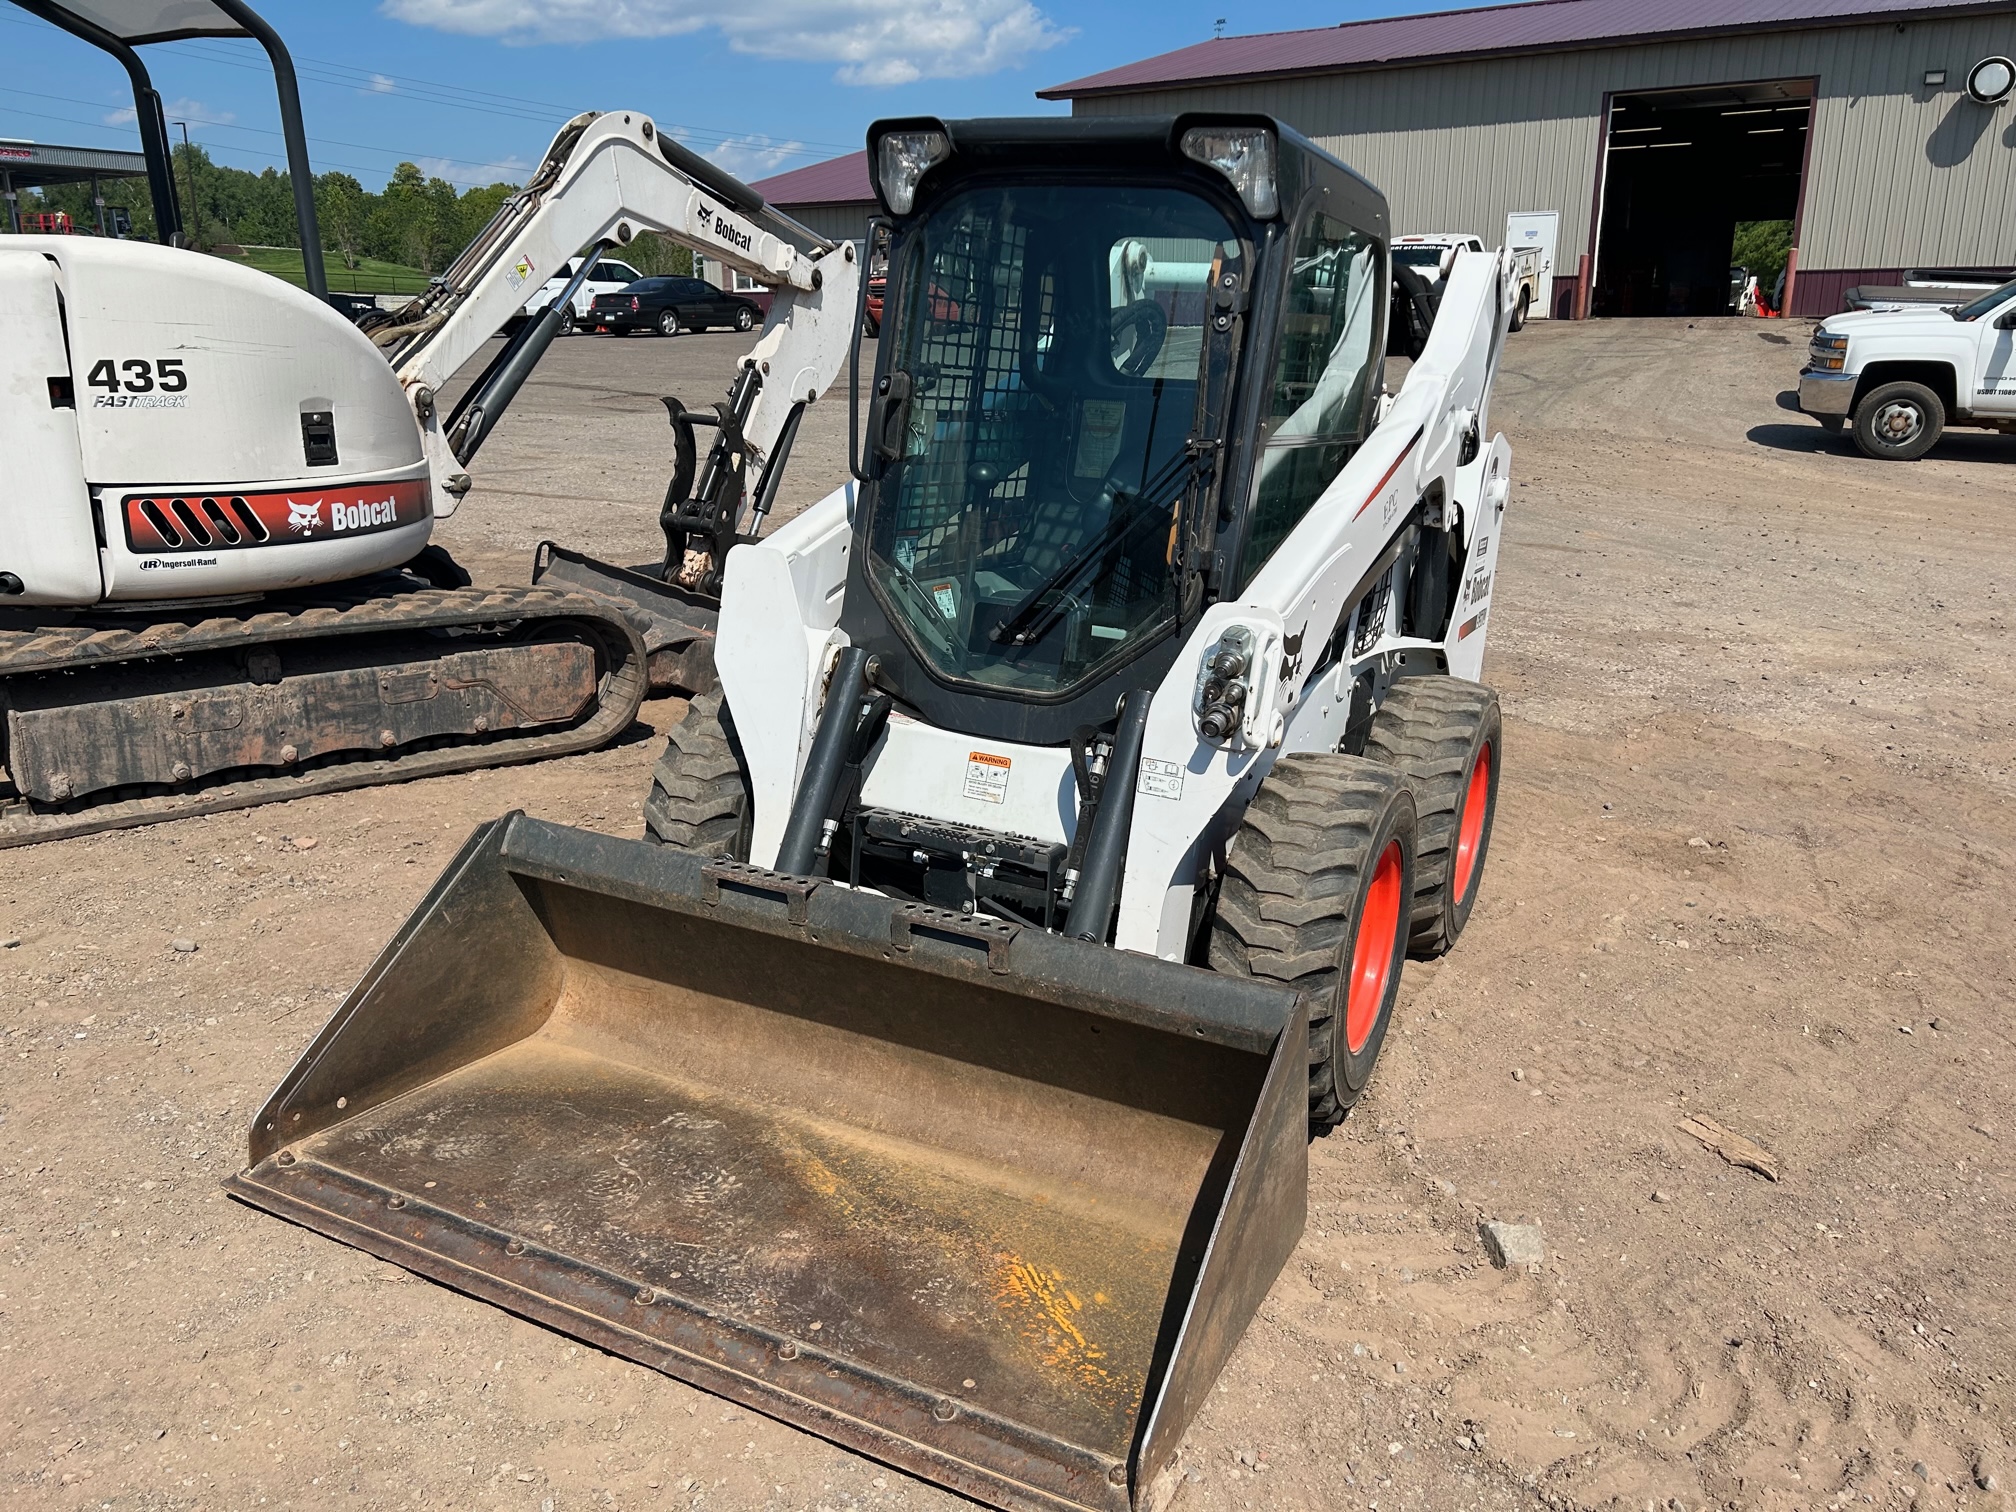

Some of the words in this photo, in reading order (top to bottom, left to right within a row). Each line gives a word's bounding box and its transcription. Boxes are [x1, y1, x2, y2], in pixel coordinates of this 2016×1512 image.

[714, 215, 752, 252] Bobcat
[87, 358, 188, 393] 435
[93, 395, 187, 408] FASTTRACK
[331, 495, 397, 531] Bobcat
[1471, 570, 1491, 605] Bobcat
[978, 755, 1008, 766] WARNING
